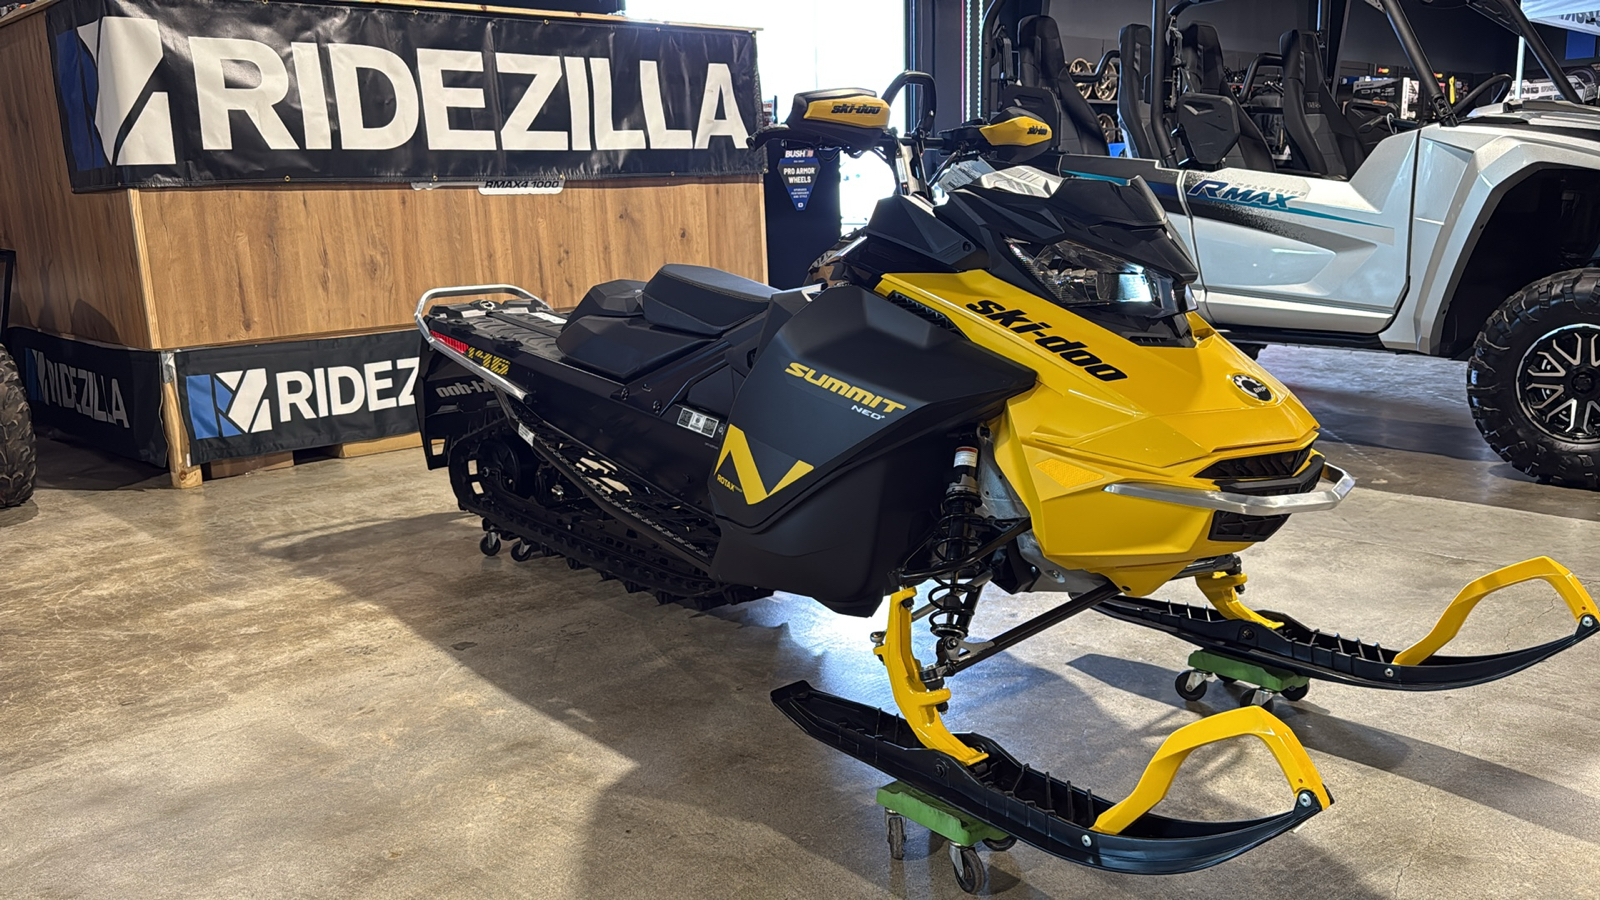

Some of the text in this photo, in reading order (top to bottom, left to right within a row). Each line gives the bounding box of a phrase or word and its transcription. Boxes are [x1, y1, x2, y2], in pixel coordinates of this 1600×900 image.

[188, 36, 749, 151] RIDEZILLA
[831, 104, 881, 114] ski-doo
[485, 180, 559, 188] RMAX4 1000
[1187, 179, 1298, 208] RMAX
[966, 299, 1128, 382] ski-doo
[46, 358, 130, 429] RIDEZILLA
[276, 356, 419, 423] RIDEZ
[785, 362, 907, 413] SUMMIT
[717, 474, 735, 492] ROTAX
